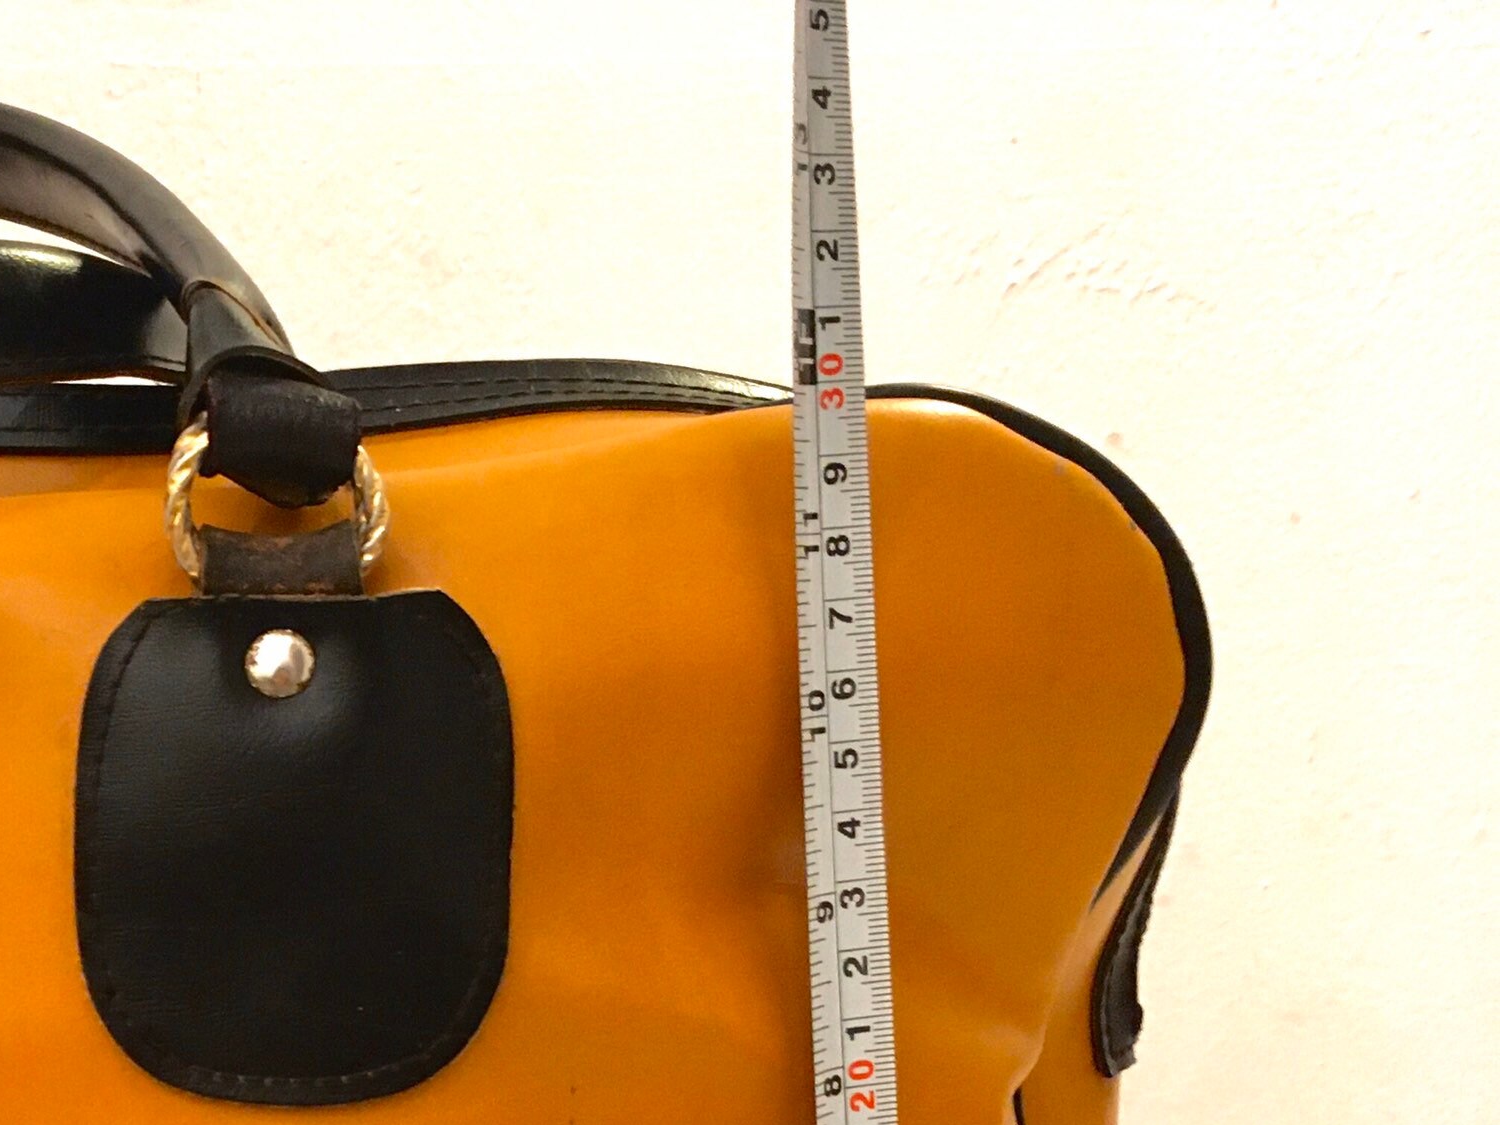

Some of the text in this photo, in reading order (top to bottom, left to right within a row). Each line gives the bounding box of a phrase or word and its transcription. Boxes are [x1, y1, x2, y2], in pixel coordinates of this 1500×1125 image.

[810, 9, 829, 31] 5
[812, 86, 831, 109] 4
[814, 163, 836, 185] 3
[816, 239, 839, 261] 2
[819, 316, 840, 330] 1
[819, 353, 845, 410] 30
[824, 462, 847, 485] 9
[826, 535, 850, 556] 8
[829, 607, 853, 629] 7
[832, 678, 856, 700] 6
[809, 690, 826, 741] 10
[834, 748, 859, 769] 5
[837, 817, 860, 839] 4
[840, 887, 865, 909] 3
[816, 901, 834, 923] 9
[843, 955, 868, 977] 2
[846, 1026, 870, 1040] 1
[824, 1075, 842, 1097] 8
[848, 1059, 875, 1112] 20
